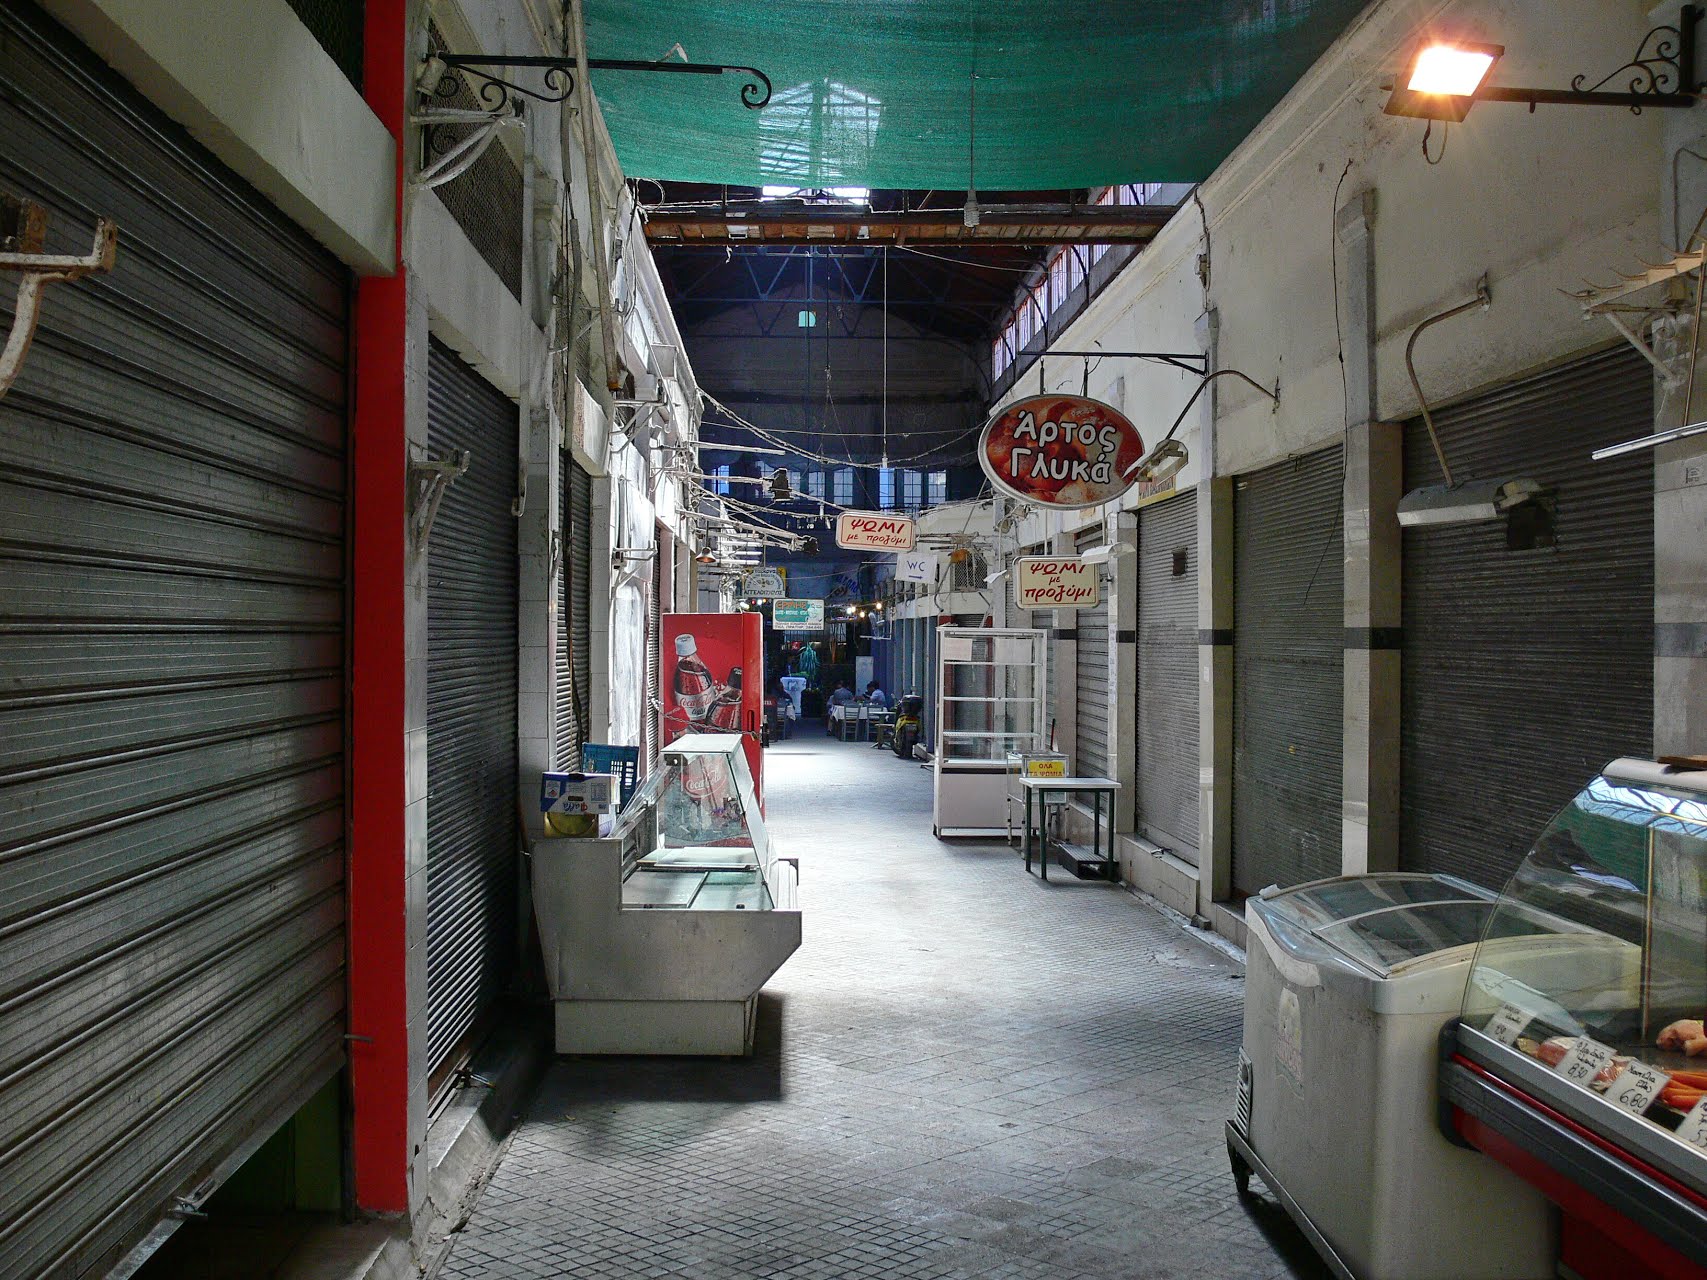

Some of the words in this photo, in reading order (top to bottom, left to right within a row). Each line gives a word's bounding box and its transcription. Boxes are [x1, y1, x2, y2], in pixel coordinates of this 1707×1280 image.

[1013, 409, 1116, 454] Άρτος
[1010, 447, 1112, 484] Γλυκά
[851, 518, 905, 534] ΨΩΜΙ
[846, 533, 859, 541] με
[866, 534, 907, 545] προζύμι
[906, 560, 925, 572] WC
[1030, 562, 1087, 575] ΨΩΜΙ
[1048, 576, 1061, 586] με
[1024, 584, 1093, 602] προζύμι
